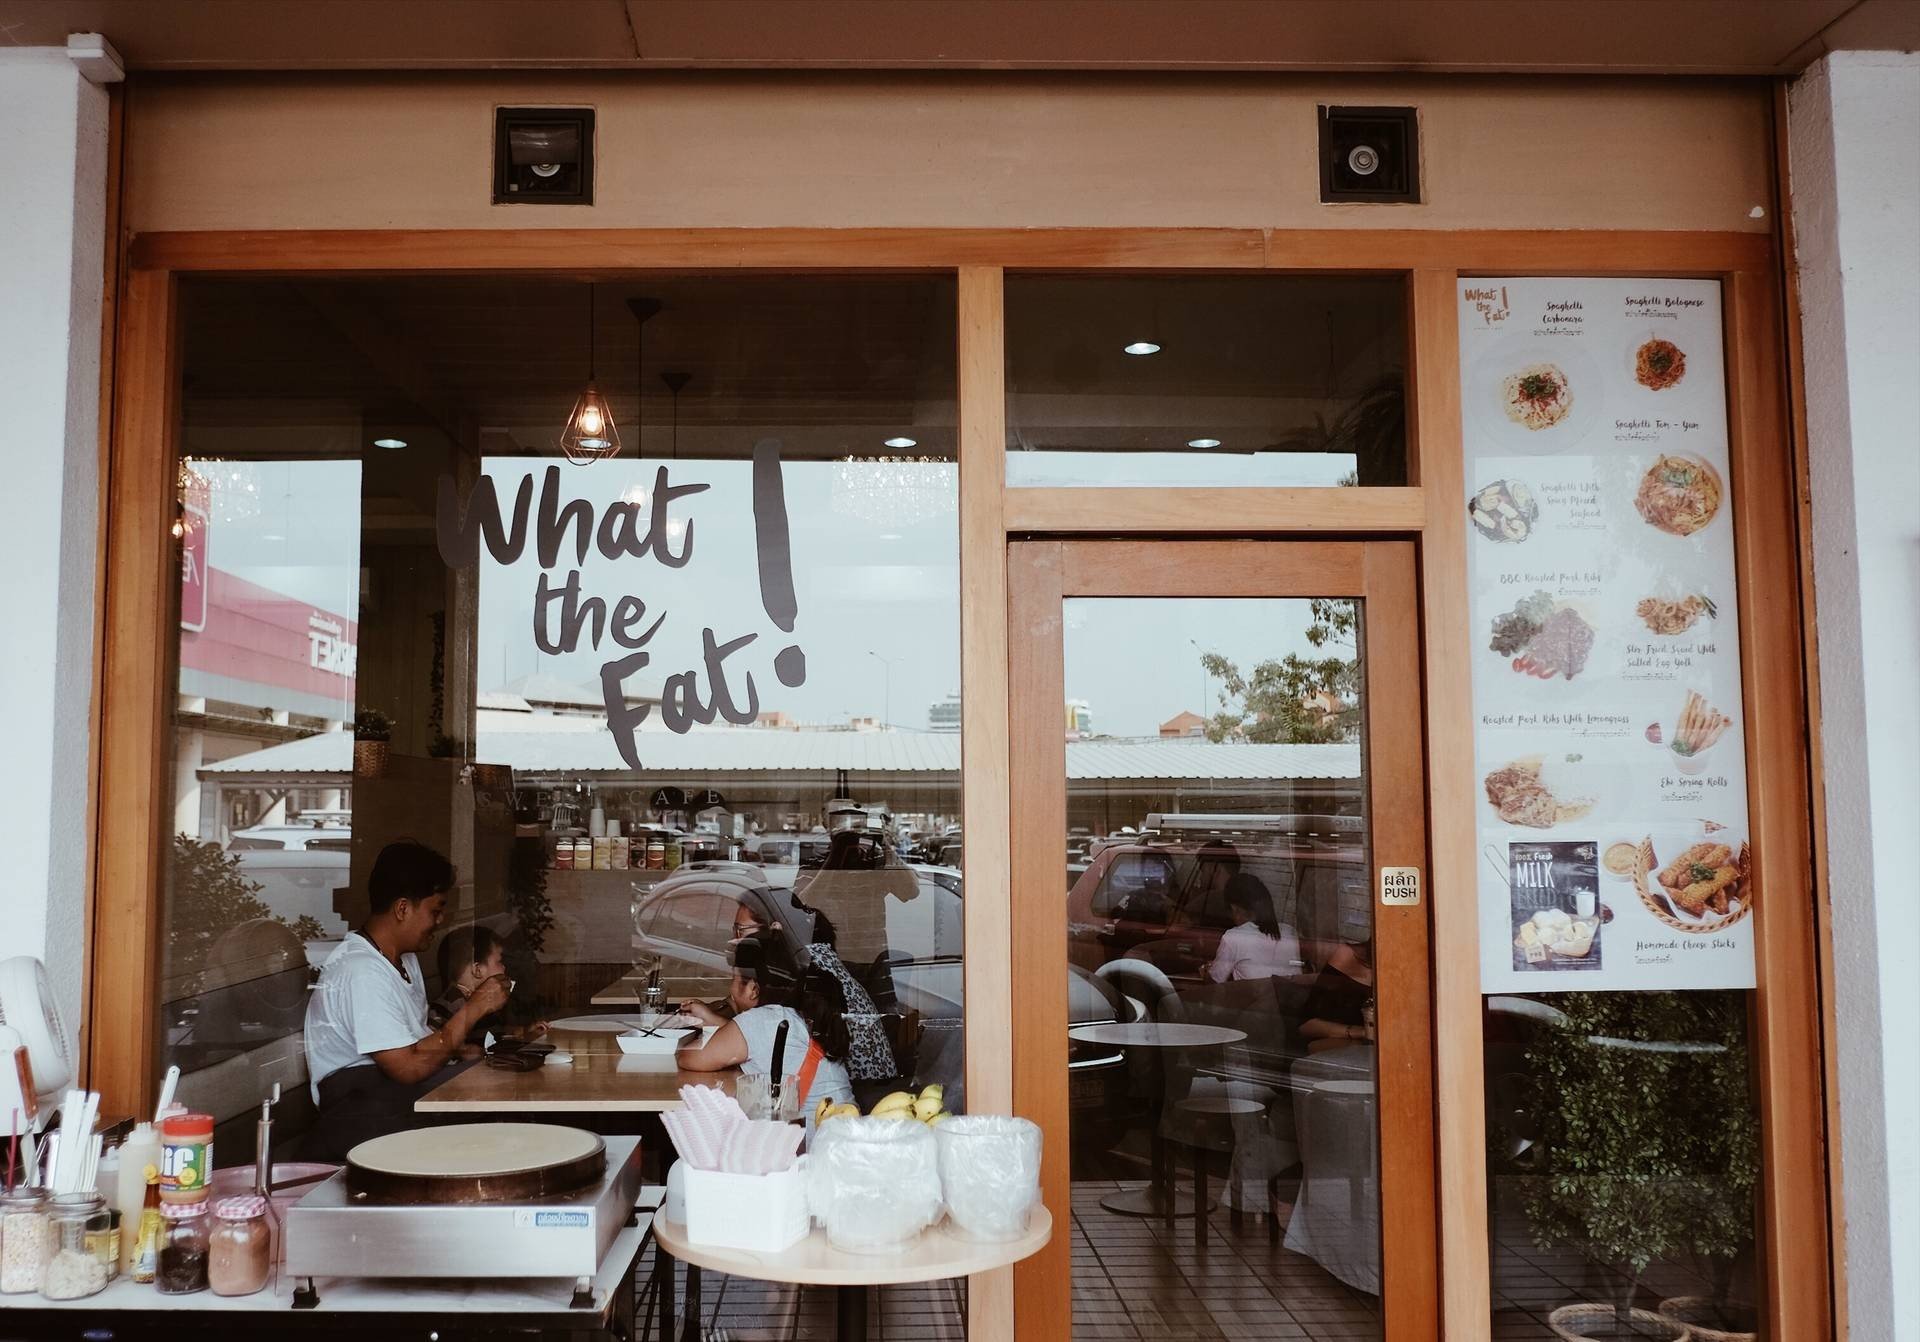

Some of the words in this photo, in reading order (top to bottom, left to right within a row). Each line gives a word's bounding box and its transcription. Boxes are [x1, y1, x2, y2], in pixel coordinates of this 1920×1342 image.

[1465, 288, 1497, 301] What
[1476, 301, 1491, 312] the
[1546, 300, 1583, 312] Spaghetti
[1625, 296, 1661, 307] Spaghetti
[1542, 313, 1583, 324] Carbonara
[1615, 419, 1650, 429] Spaghetti
[436, 465, 711, 569] What
[534, 570, 667, 656] the
[1697, 644, 1716, 655] With
[600, 627, 760, 771] Fat
[1483, 715, 1514, 725] Roasted
[1518, 714, 1537, 726] Pork
[1543, 714, 1560, 725] Ribs
[1563, 713, 1583, 725] With
[1587, 714, 1630, 725] Lemongrass
[1707, 776, 1727, 787] Rolls
[628, 788, 720, 806] CAFE
[1534, 851, 1553, 861] Fresh
[1384, 871, 1417, 886] ผลัก
[1516, 861, 1555, 889] MILK
[1384, 887, 1417, 898] PUSH
[1636, 939, 1678, 951] Homemade
[1682, 939, 1707, 950] Cheese
[1712, 938, 1736, 949] Sticks
